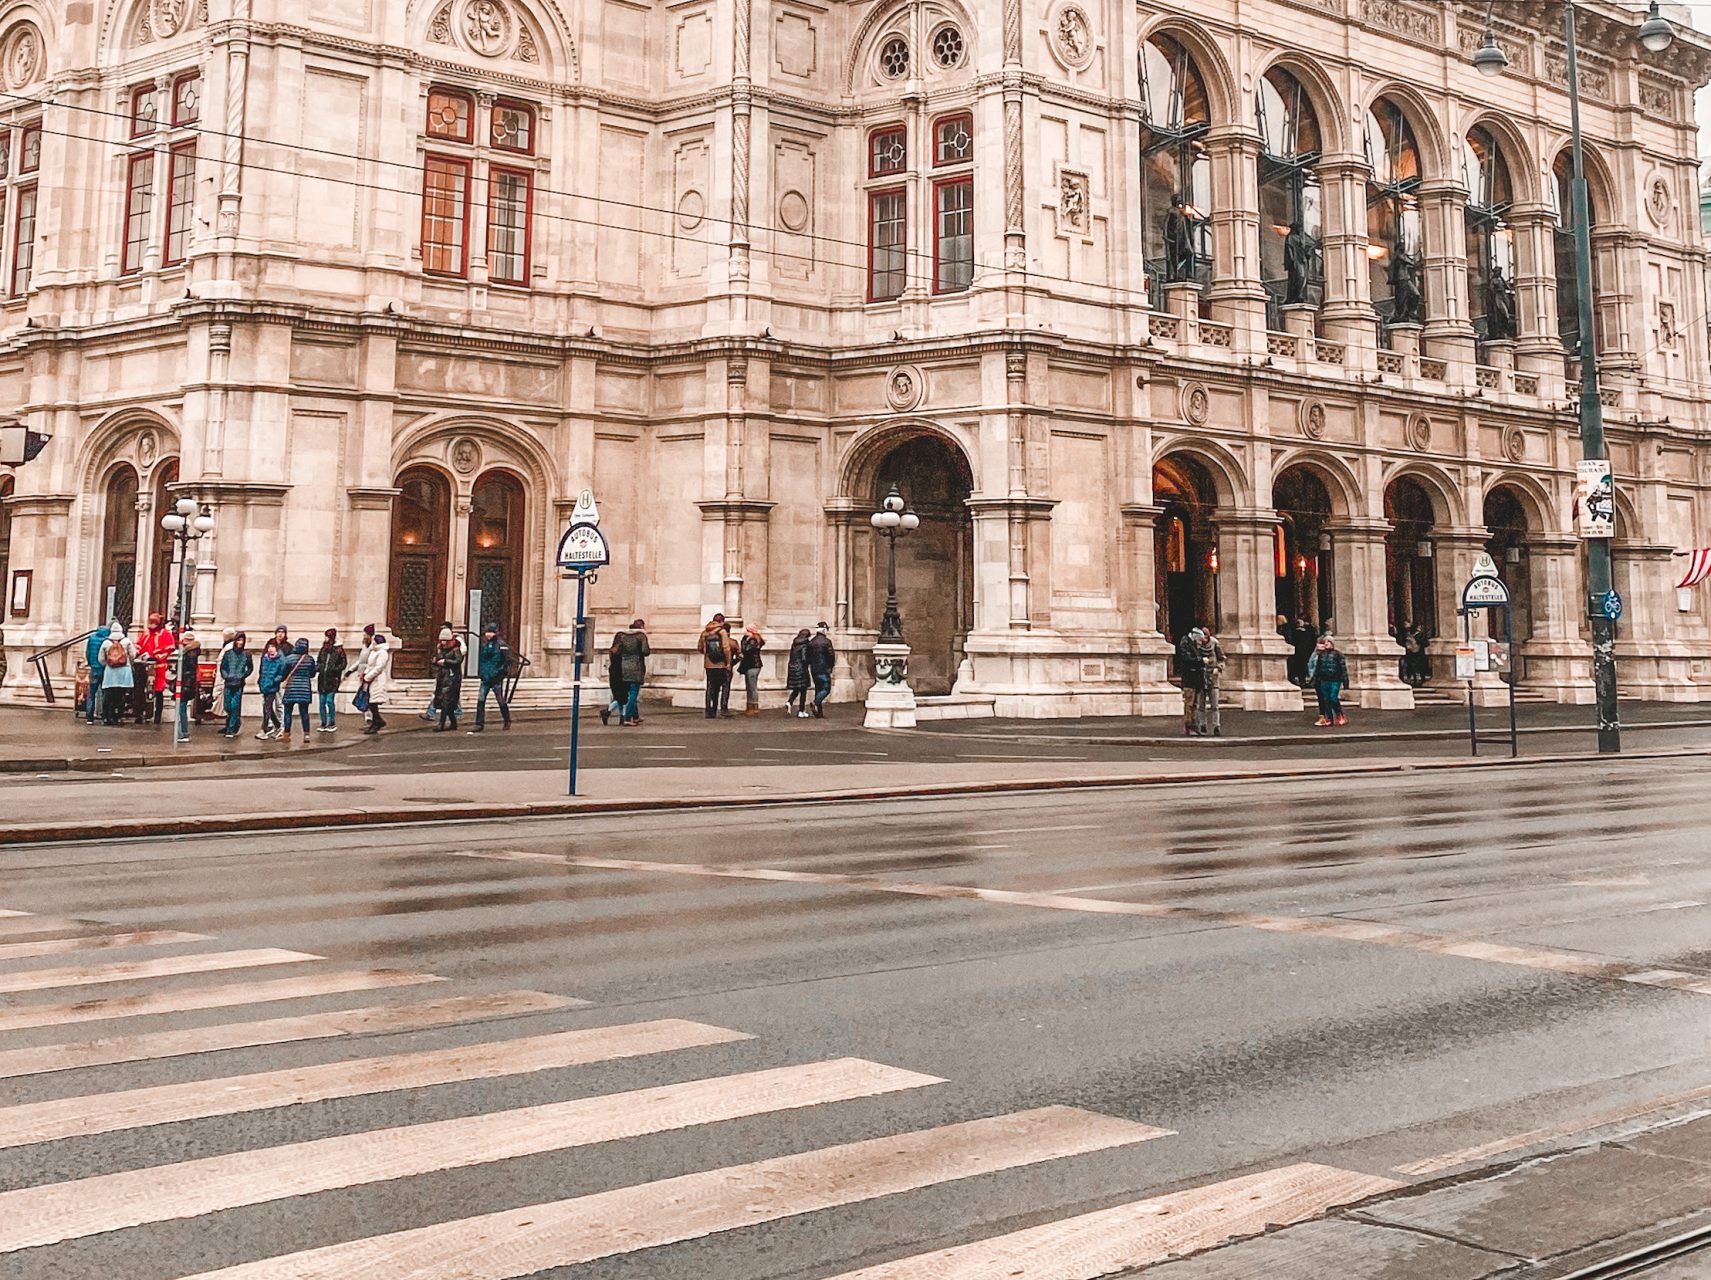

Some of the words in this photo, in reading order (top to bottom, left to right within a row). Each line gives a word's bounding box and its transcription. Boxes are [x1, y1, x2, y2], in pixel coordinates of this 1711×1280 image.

[570, 529, 598, 543] AUTOBUS
[564, 551, 602, 560] HALTESTELLE
[1473, 579, 1499, 590] AUTOBUS
